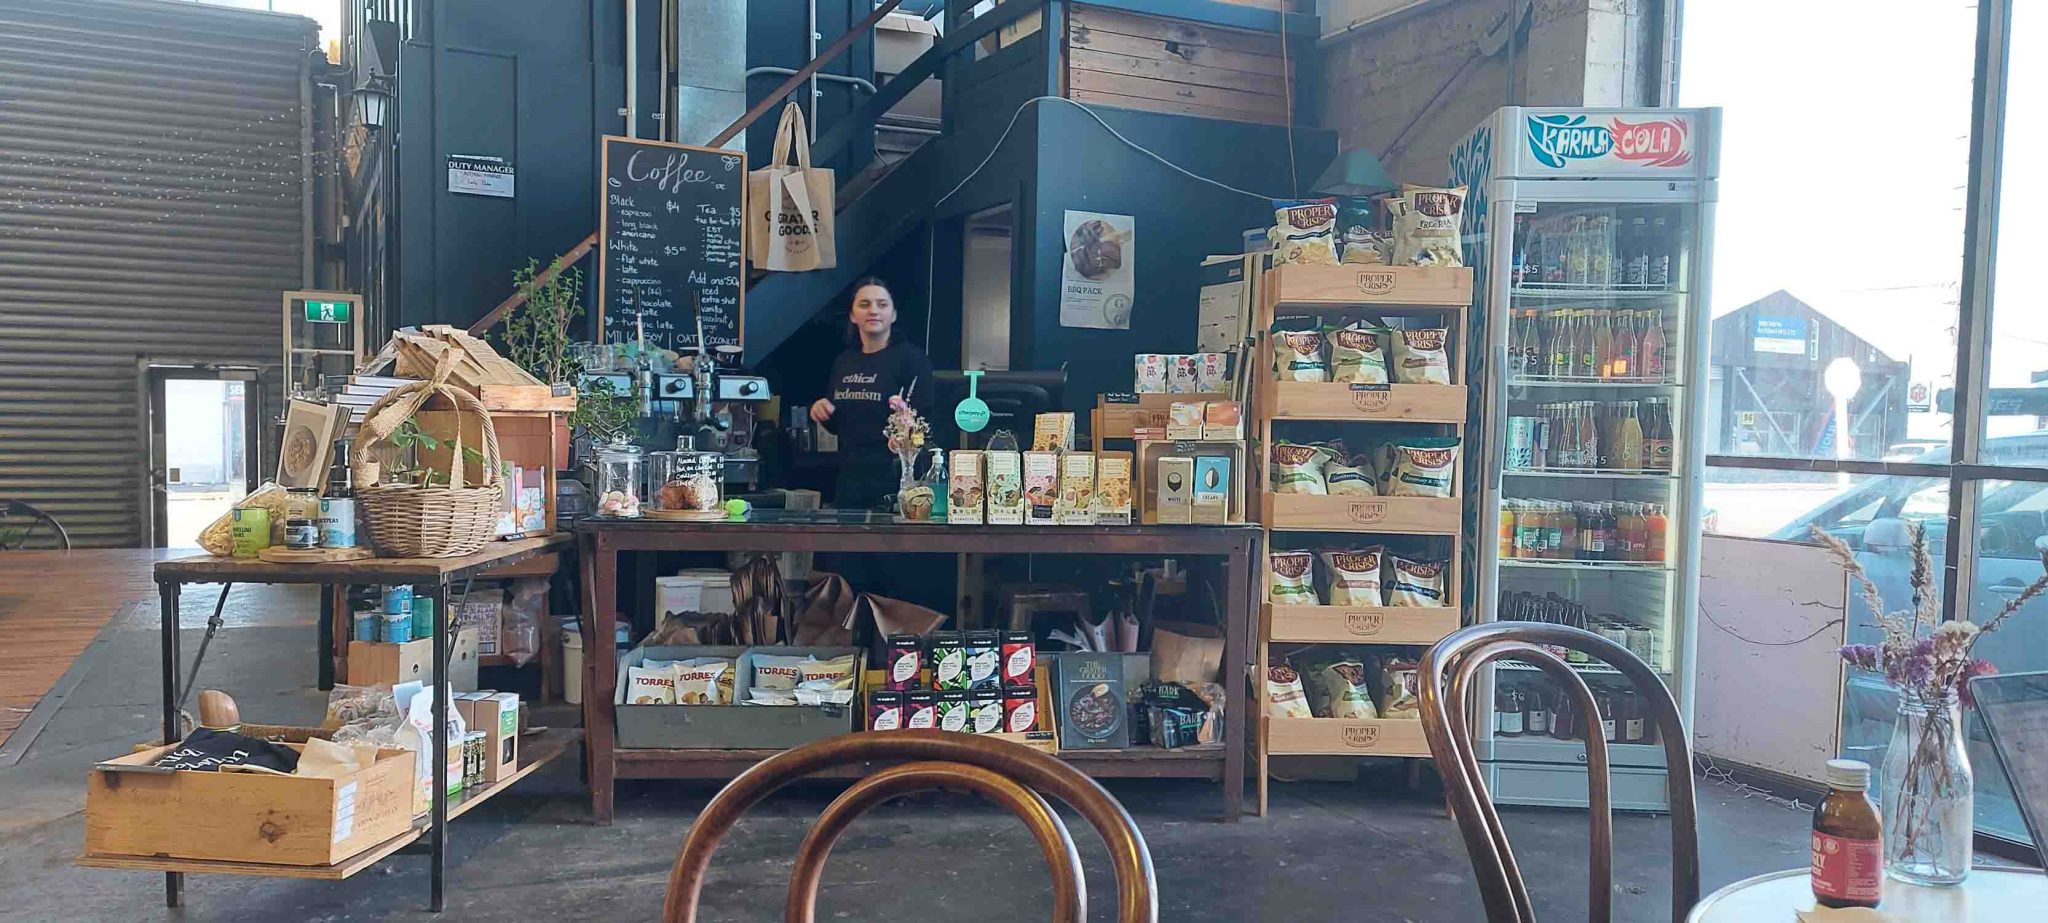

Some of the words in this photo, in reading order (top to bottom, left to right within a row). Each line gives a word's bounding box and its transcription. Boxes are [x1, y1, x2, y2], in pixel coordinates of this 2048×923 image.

[1541, 122, 1609, 167] KARMA
[1621, 126, 1671, 155] COLA
[448, 161, 472, 170] DUTY
[473, 164, 514, 174] MANAGER
[626, 150, 712, 194] Coffee
[609, 194, 635, 207] Black
[666, 200, 680, 214] $4
[621, 209, 652, 217] espresso
[696, 203, 717, 215] Tea
[729, 206, 741, 217] $5
[1291, 205, 1332, 220] PROPER
[622, 219, 637, 232] long
[639, 221, 659, 231] black
[1297, 215, 1328, 227] CRISPS
[609, 239, 639, 252] White
[621, 253, 635, 264] flat
[639, 257, 660, 267] white
[621, 265, 639, 274] latte
[1524, 264, 1540, 275] $5
[621, 277, 662, 287] cappuccino
[687, 270, 707, 285] Add
[1360, 274, 1393, 284] PROPER
[702, 285, 719, 296] iced
[1083, 287, 1102, 295] PACK
[1364, 281, 1388, 290] CRISPS
[621, 296, 633, 305] hot
[640, 299, 673, 308] hocolate
[701, 295, 720, 304] extra
[721, 296, 737, 305] shot
[621, 307, 636, 315] cha
[642, 307, 659, 316] latte
[701, 305, 723, 314] vanilla
[605, 329, 636, 345] MILK
[643, 331, 664, 342] SOY
[676, 333, 699, 344] OAT
[704, 334, 739, 346] COCONUT
[842, 372, 878, 384] ethical
[1355, 390, 1388, 401] PROPER
[1351, 503, 1383, 513] PROPER
[1342, 562, 1372, 571] CRISPS
[1406, 565, 1435, 575] CRISPS
[1348, 614, 1380, 625] PROPER
[636, 678, 674, 688] TORRES
[679, 671, 715, 682] TORRES
[758, 667, 798, 677] TORRES
[1158, 685, 1180, 697] BARK
[1345, 727, 1377, 738] PROPER
